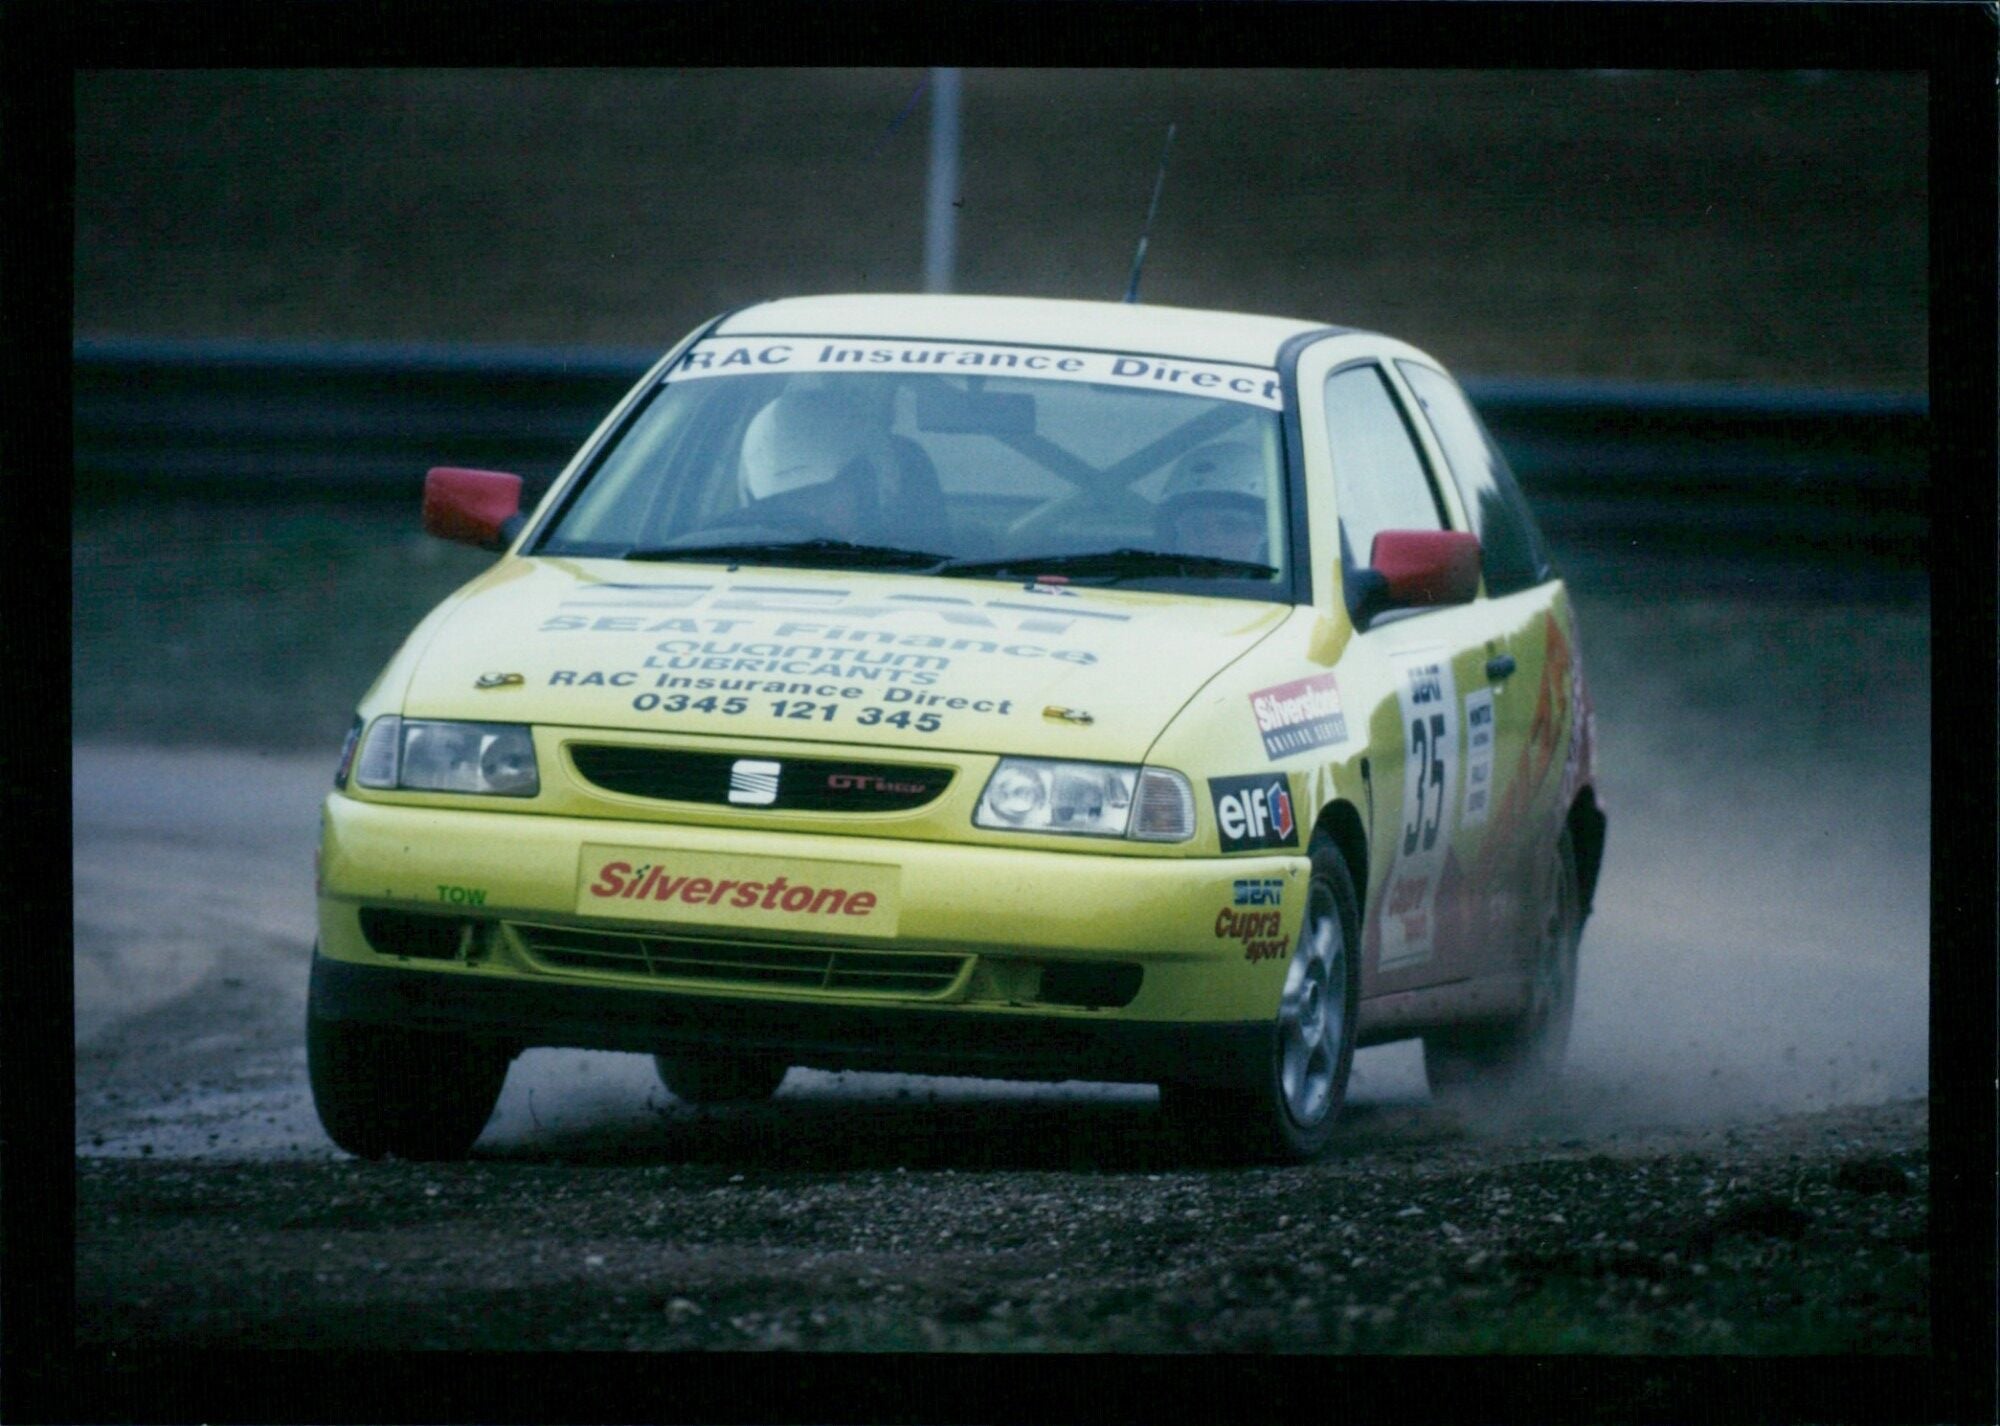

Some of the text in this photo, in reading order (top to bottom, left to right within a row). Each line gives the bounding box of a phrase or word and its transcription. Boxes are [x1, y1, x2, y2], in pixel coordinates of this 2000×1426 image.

[681, 345, 1281, 401] RAC Insurance Direct
[540, 614, 1098, 664] SEAT Finance
[643, 656, 938, 685] LUBRICANTS
[549, 671, 1012, 715] RAC Insurance Direct
[633, 693, 943, 733] 0345 121 345
[1403, 713, 1446, 857] 35
[1219, 788, 1268, 840] elf
[437, 885, 487, 905] TOW
[591, 861, 877, 916] Silverstone
[1233, 880, 1284, 906] SEAT
[1215, 907, 1281, 943] Cupra
[1244, 936, 1290, 964] sport
